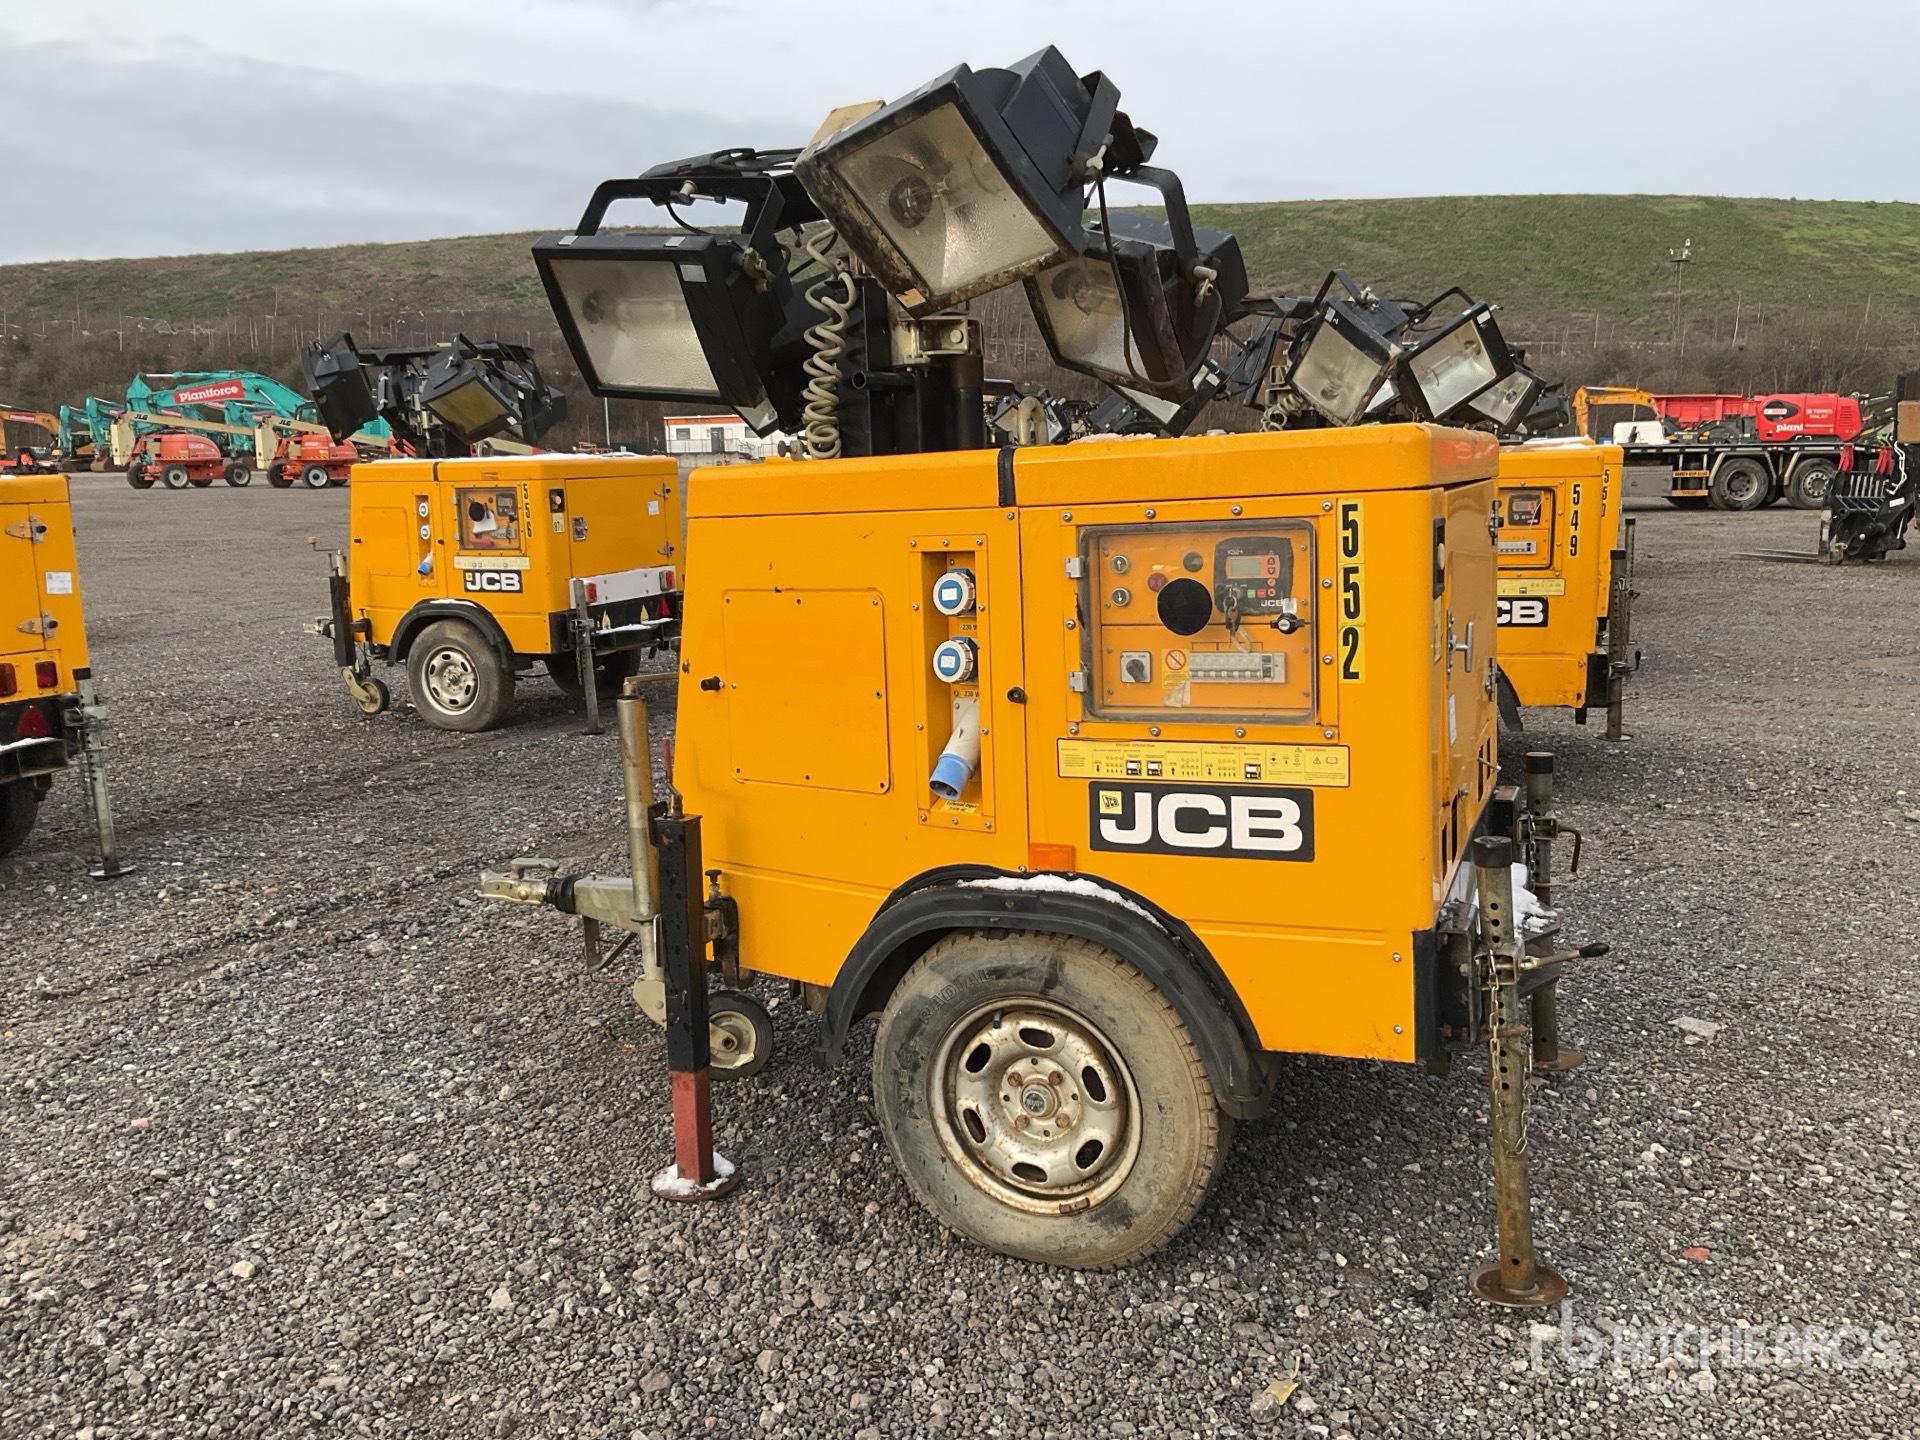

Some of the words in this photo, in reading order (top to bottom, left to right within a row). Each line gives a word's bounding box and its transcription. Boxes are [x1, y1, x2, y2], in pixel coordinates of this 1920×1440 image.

[178, 386, 239, 401] Plantforce
[1569, 484, 1581, 557] 549
[465, 572, 521, 591] JCB
[1342, 503, 1361, 680] 552
[1099, 791, 1304, 852] JCB
[917, 969, 996, 1026] RADIAL
